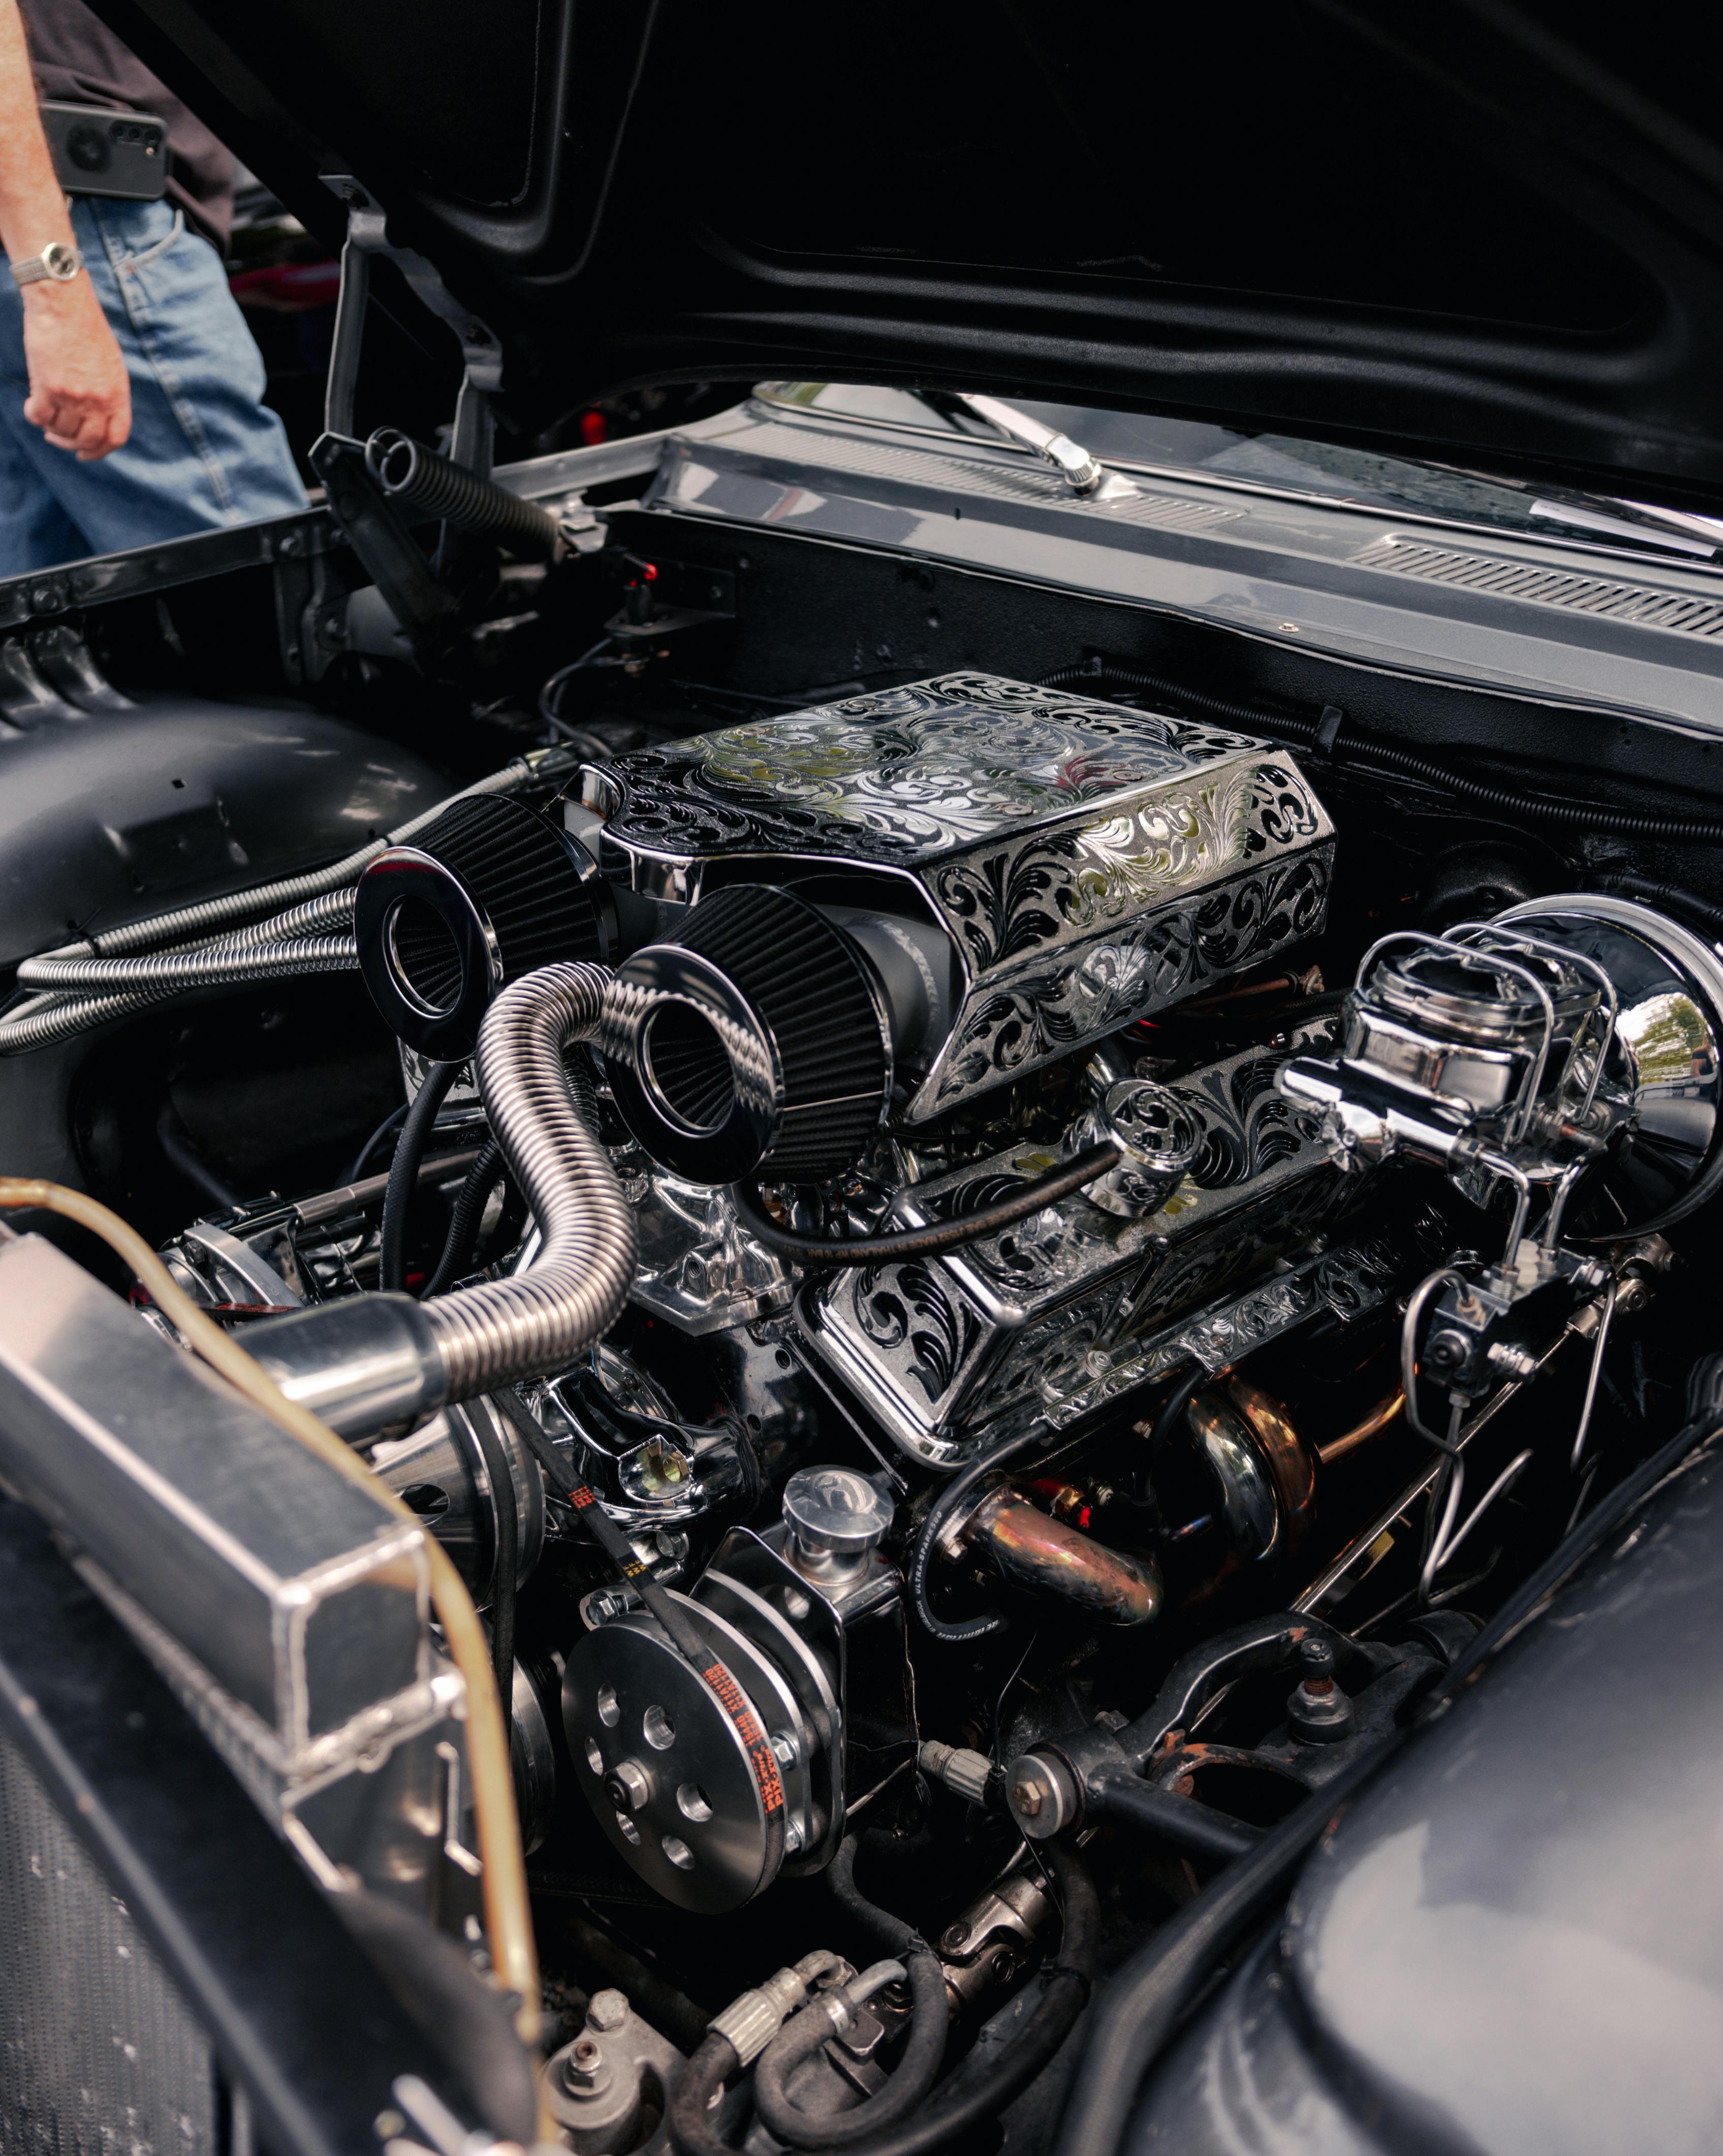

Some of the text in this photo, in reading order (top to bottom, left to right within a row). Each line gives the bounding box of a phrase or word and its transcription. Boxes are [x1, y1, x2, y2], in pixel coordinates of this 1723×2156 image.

[965, 1220, 986, 1232] SAE
[896, 1242, 907, 1252] IN
[908, 1234, 938, 1249] MADE
[806, 1248, 823, 1259] BAR
[850, 1244, 894, 1259] THAILAND
[985, 1620, 999, 1632] RE
